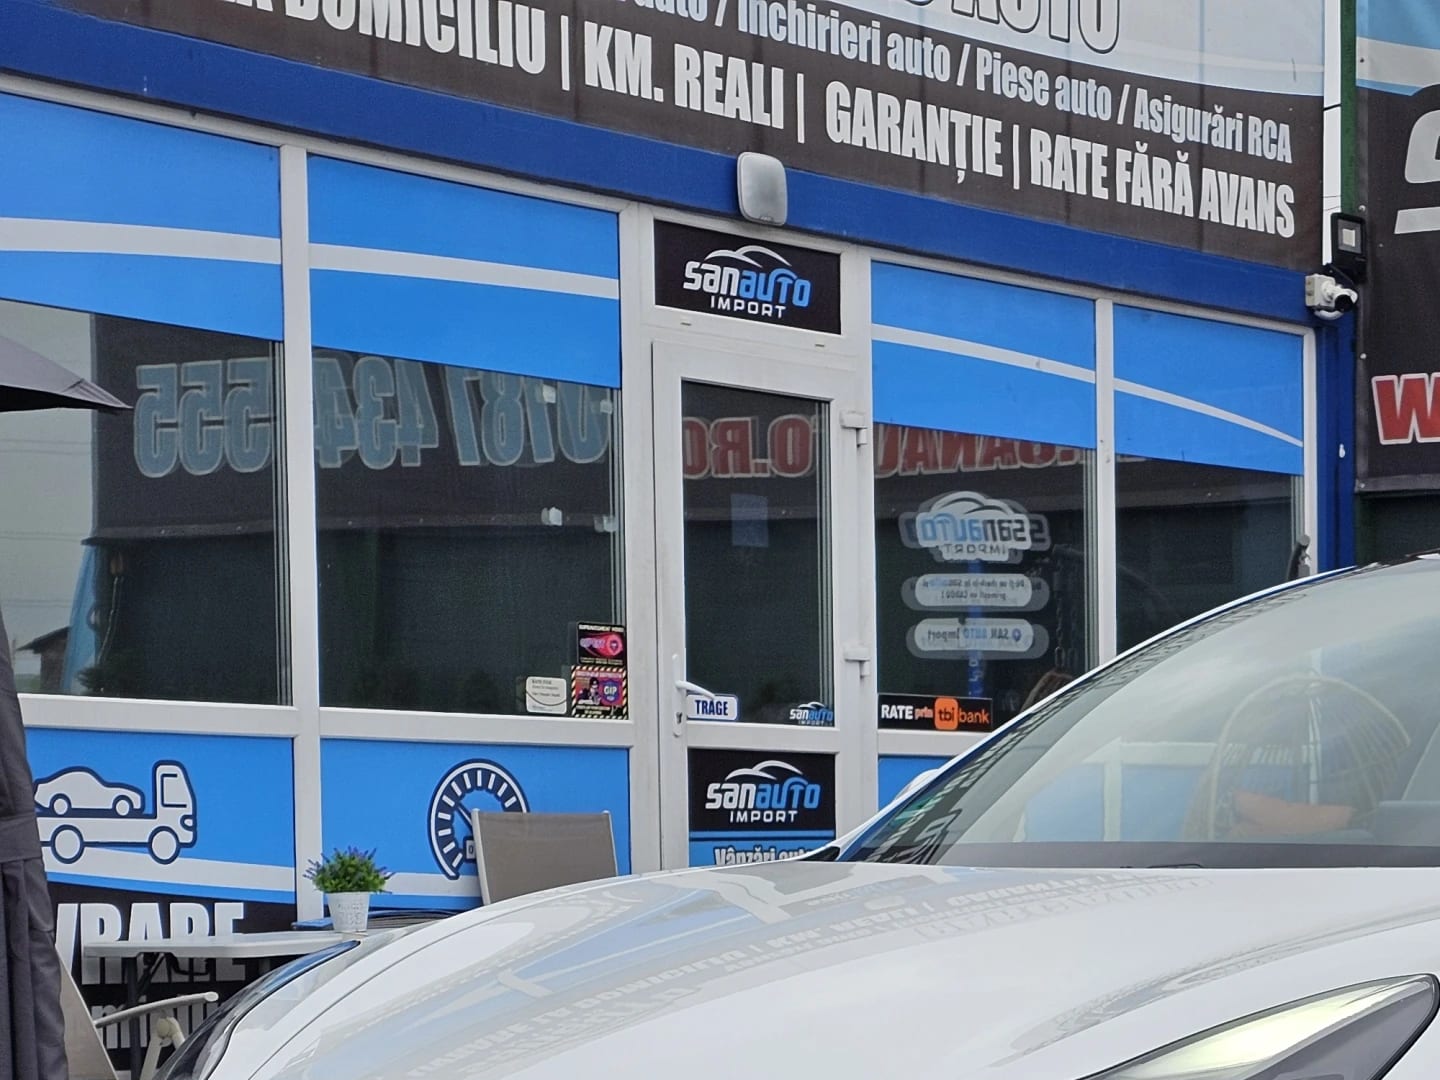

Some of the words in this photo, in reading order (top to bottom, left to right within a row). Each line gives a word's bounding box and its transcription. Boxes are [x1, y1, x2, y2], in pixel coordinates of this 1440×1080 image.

[887, 32, 950, 82] auto
[976, 47, 1049, 107] Piese
[1055, 75, 1112, 121] auto
[1133, 88, 1244, 152] Asigurări
[1247, 116, 1293, 164] RCA
[584, 23, 664, 103] KM.
[674, 43, 785, 130] REALI
[825, 81, 1002, 184] GARANȚIE
[1030, 129, 1109, 200] RATE
[1115, 141, 1191, 218] FĂRĂ
[1198, 168, 1296, 239] AVANS
[710, 295, 786, 319] IMPORT
[694, 699, 729, 717] TRAGE
[881, 704, 913, 721] RATE
[938, 706, 956, 723] tbi
[958, 706, 990, 725] bank
[729, 810, 799, 824] IMPORT
